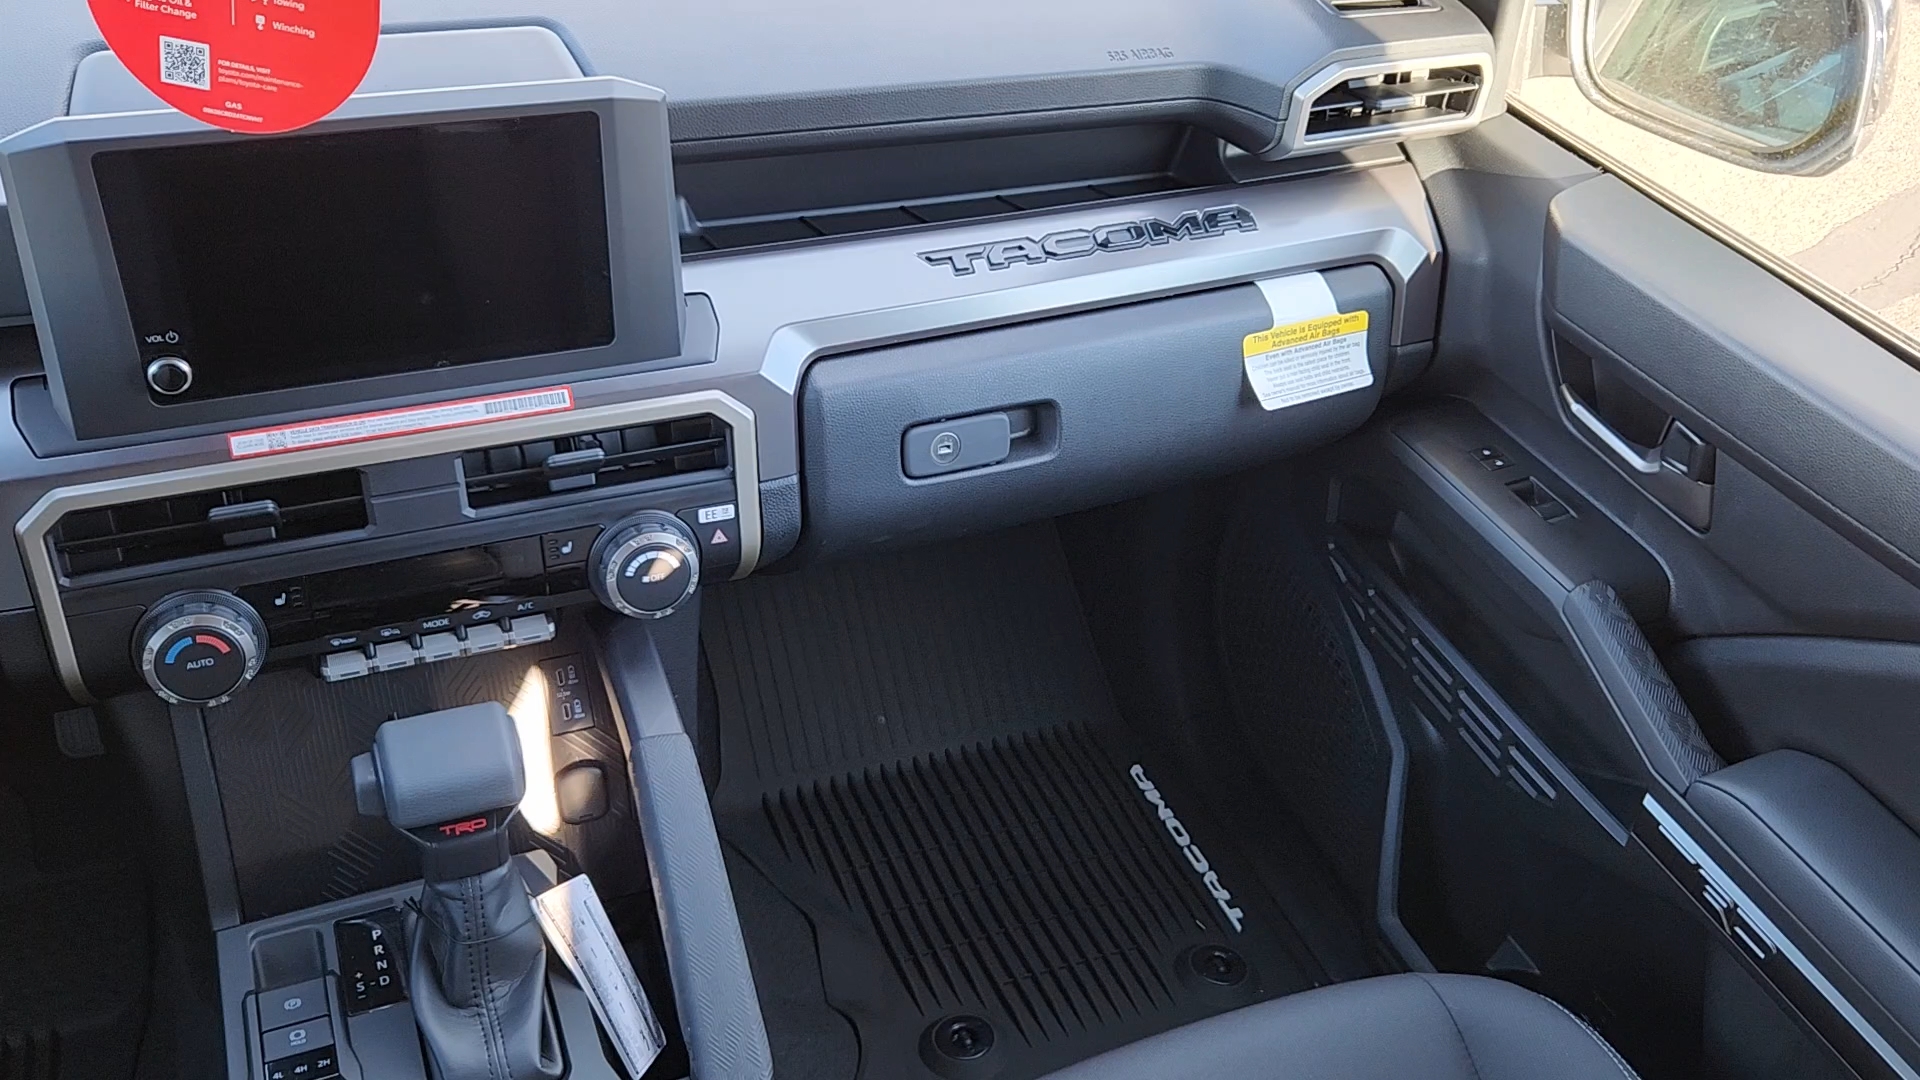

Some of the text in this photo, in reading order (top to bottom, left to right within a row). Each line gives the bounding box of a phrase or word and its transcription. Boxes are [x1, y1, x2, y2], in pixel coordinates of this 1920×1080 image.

[135, 0, 197, 20] Filter Change
[272, 21, 315, 38] Winching
[225, 101, 242, 110] GAS
[916, 204, 1259, 277] TACOMA
[1253, 334, 1268, 343] This
[1270, 328, 1297, 338] Vehicle
[1307, 319, 1342, 332] Equipped
[1344, 315, 1359, 323] with
[1271, 335, 1307, 347] Advanced
[1322, 328, 1340, 338] Bags
[1293, 343, 1322, 352] Advanced
[705, 509, 718, 520] EE
[517, 602, 534, 611] A/C
[423, 618, 450, 629] MODE
[186, 658, 214, 670] AUTO
[440, 818, 487, 835] TRD
[1130, 764, 1244, 932] TACOMA
[372, 929, 382, 940] P
[374, 944, 385, 955] R
[376, 960, 388, 970] N
[356, 976, 390, 992] S D
[294, 1065, 308, 1073] 4H
[318, 1058, 330, 1068] 2H
